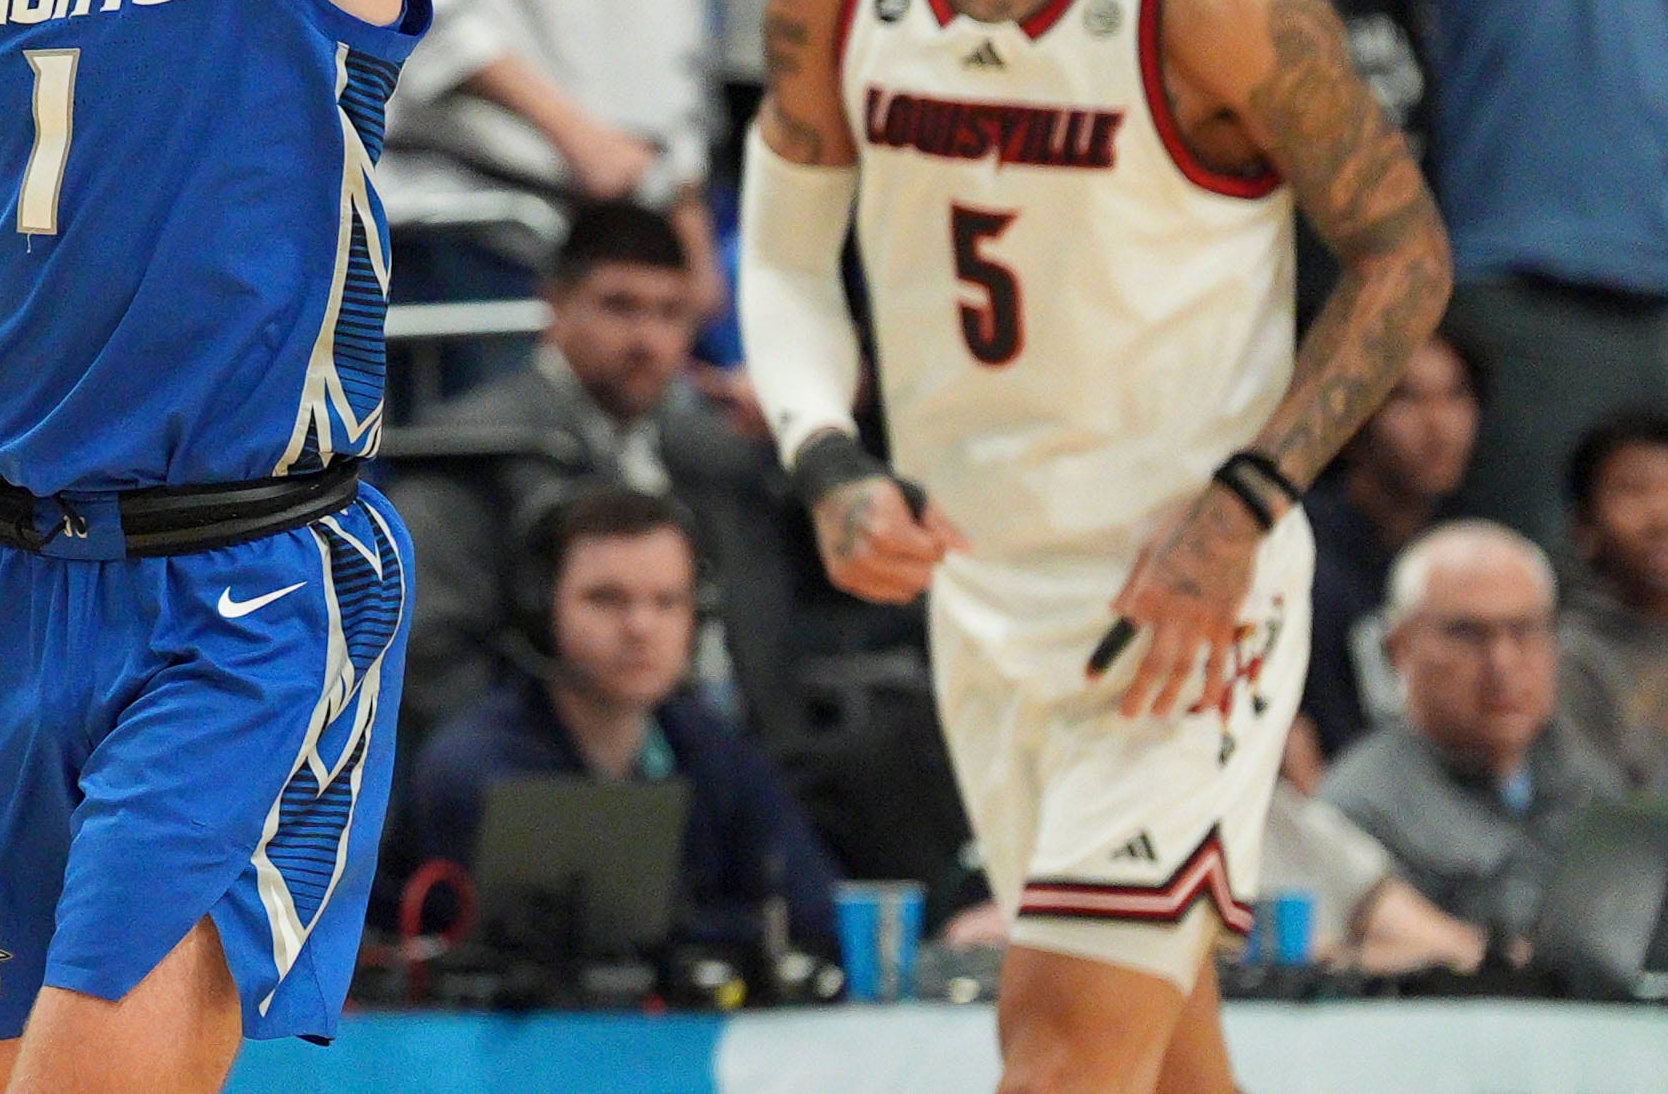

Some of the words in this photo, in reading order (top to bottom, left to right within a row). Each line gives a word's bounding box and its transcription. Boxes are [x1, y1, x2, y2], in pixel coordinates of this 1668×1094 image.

[17, 48, 80, 235] 1
[865, 86, 1124, 172] LOUISVILLE
[951, 203, 1025, 368] 5
